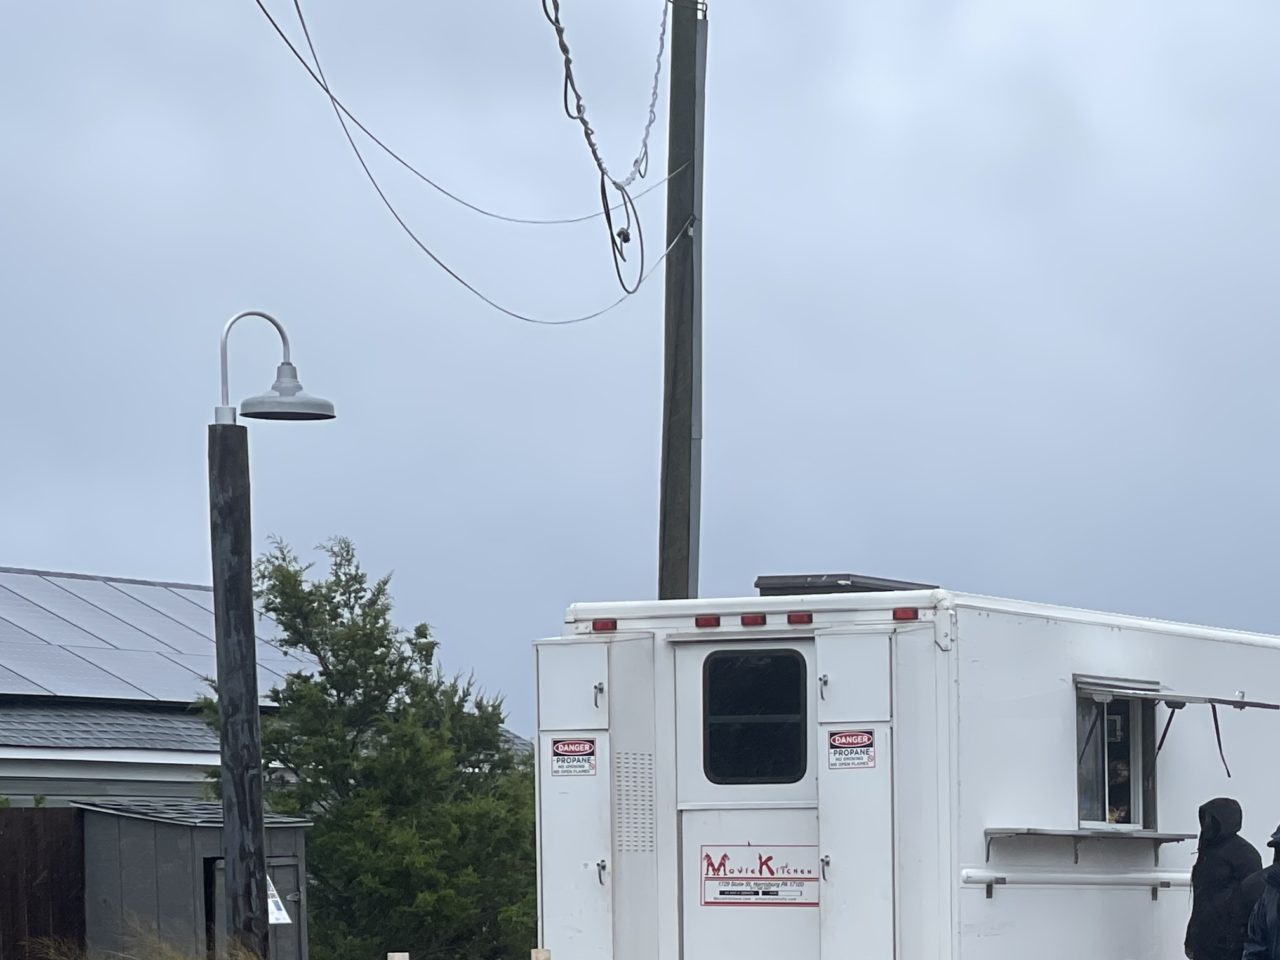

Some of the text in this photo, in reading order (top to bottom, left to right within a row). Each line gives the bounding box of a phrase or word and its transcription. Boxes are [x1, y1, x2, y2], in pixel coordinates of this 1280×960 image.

[835, 735, 868, 744] DANGER
[558, 743, 590, 752] DANGER
[833, 748, 870, 756] PROPANE
[556, 756, 592, 764] PROPANE
